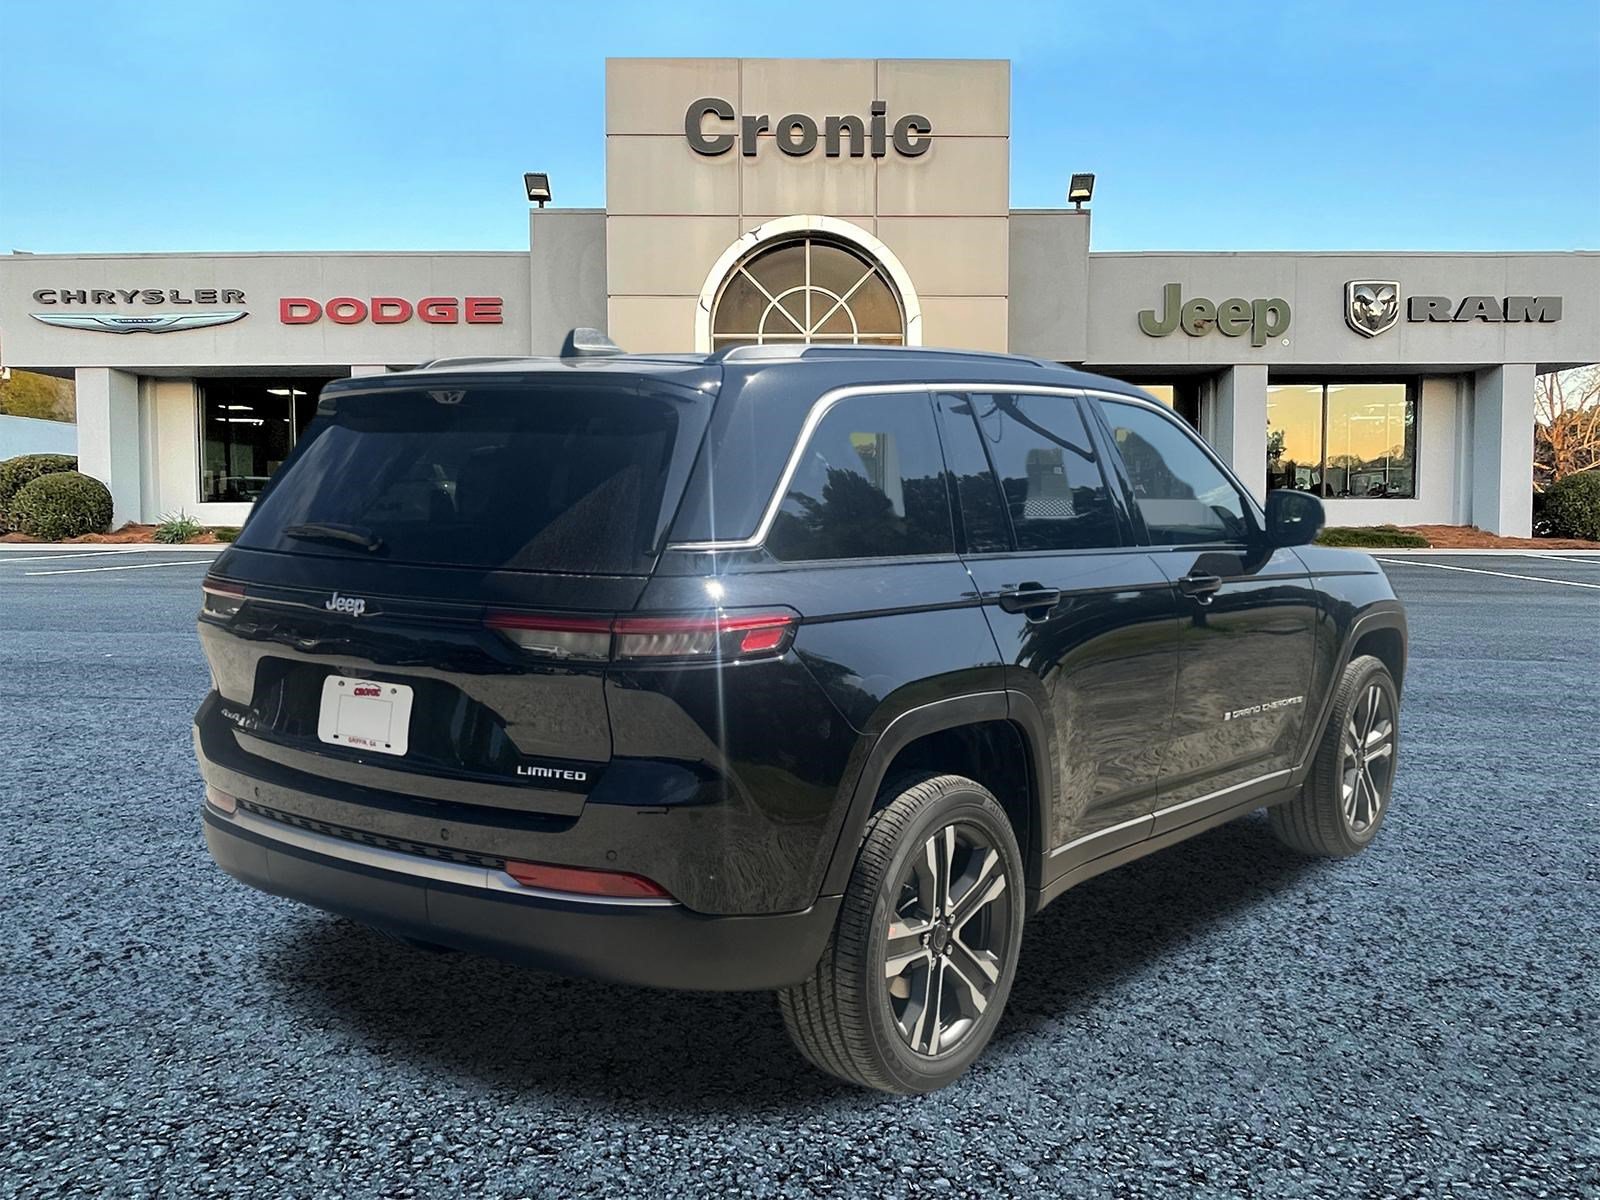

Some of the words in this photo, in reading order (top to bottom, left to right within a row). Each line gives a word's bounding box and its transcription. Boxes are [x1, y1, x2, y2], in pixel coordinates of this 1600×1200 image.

[685, 97, 932, 157] Cronic
[32, 289, 246, 304] CHRYSLER
[1407, 296, 1563, 322] RAM
[280, 297, 503, 324] DODGE
[1138, 283, 1291, 347] Jeep
[325, 591, 366, 617] Jeep
[517, 765, 587, 781] LIMITED
